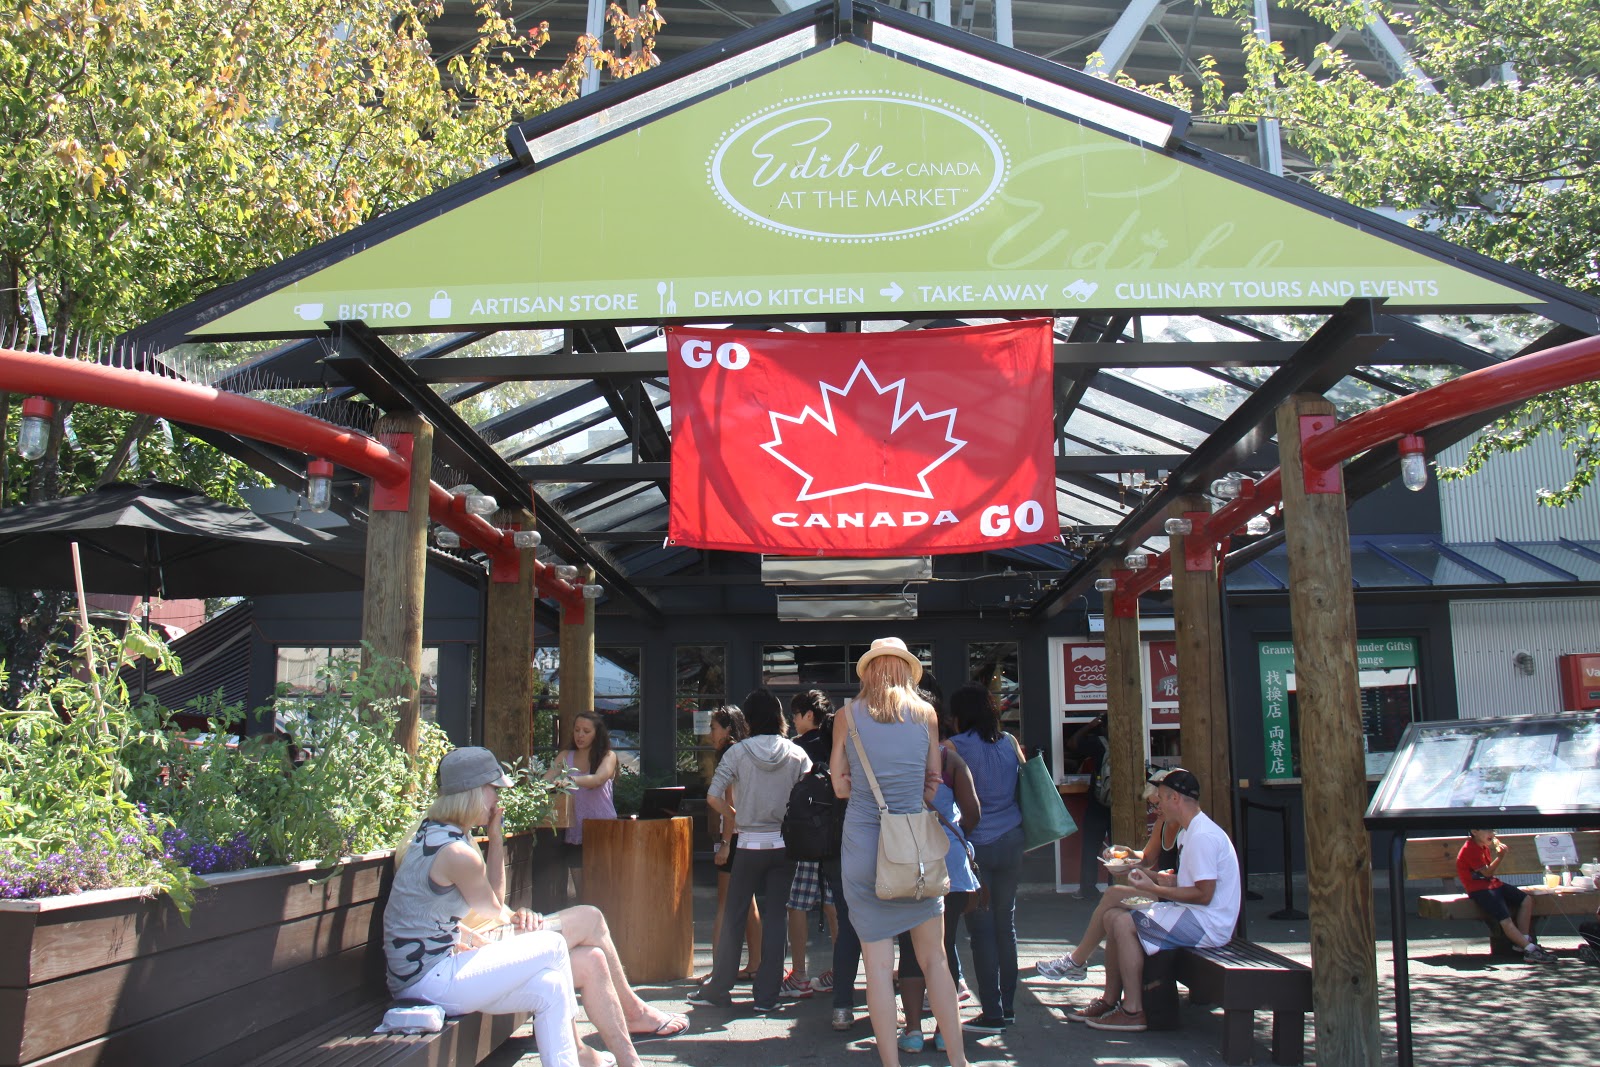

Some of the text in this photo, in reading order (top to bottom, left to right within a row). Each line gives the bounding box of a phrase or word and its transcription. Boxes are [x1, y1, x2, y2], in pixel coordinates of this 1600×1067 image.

[752, 117, 981, 187] Edible CANADA
[777, 191, 806, 209] AT
[813, 190, 859, 208] THE
[865, 188, 960, 207] MARKET
[338, 280, 1439, 321] BISTRO ARTISAN STORE DEMO KITCHEN TAKE-AWAY CULINARY TOURS AND EVENTS
[680, 339, 750, 370] GO
[771, 500, 1044, 537] CANADA GO
[1262, 645, 1295, 655] Granvi
[1586, 668, 1600, 677] Va
